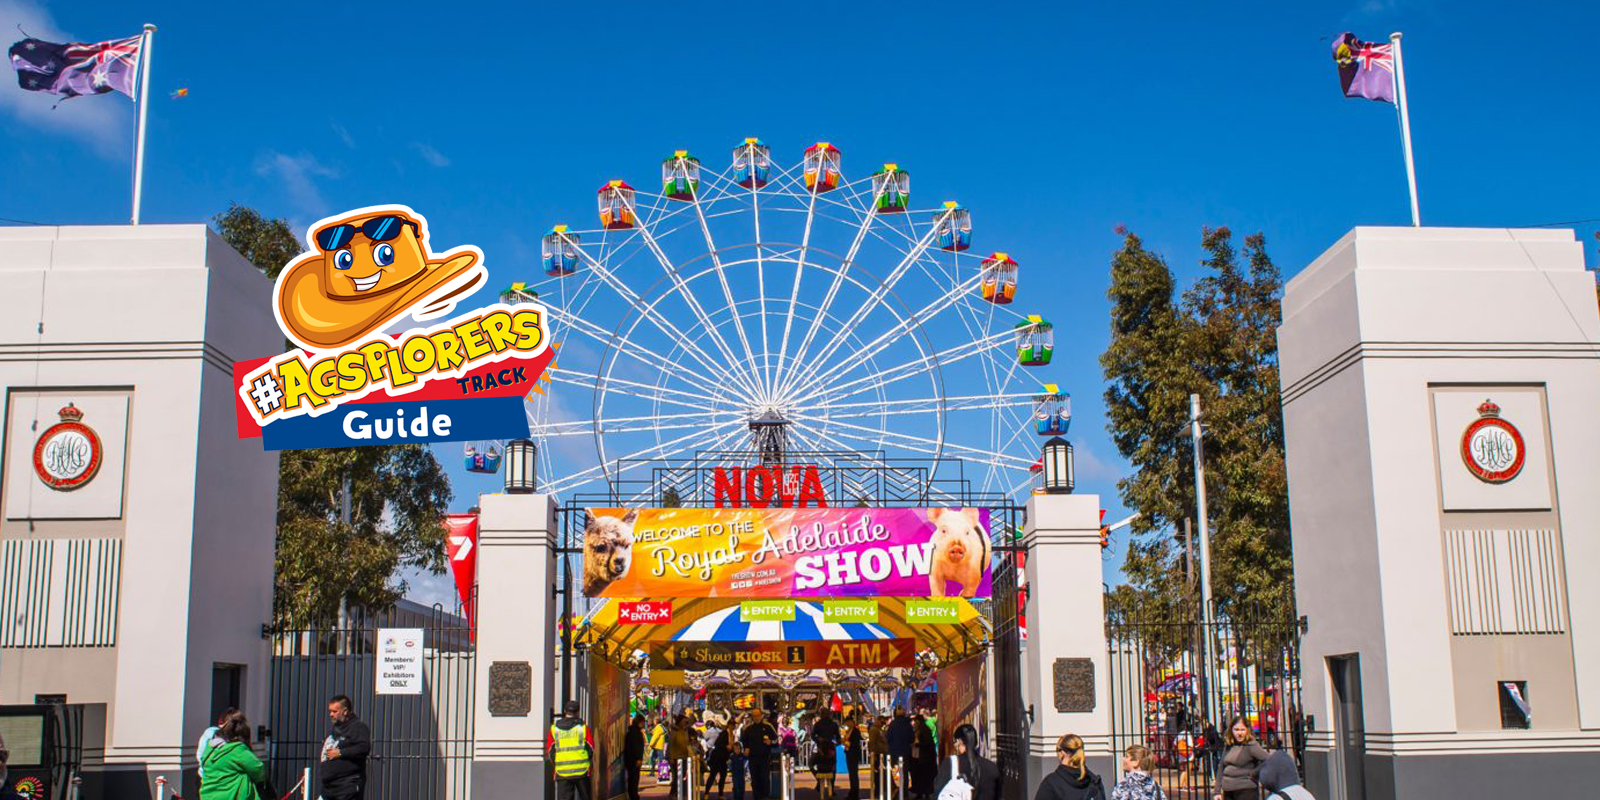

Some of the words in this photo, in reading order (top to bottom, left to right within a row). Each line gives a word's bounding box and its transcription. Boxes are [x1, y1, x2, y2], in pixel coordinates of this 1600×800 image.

[714, 465, 828, 508] NOVA
[633, 525, 701, 543] WELCOME
[704, 523, 724, 536] TO
[728, 520, 754, 535] THE
[652, 534, 745, 580] Royal
[752, 515, 890, 564] Adelaide
[794, 542, 936, 590] SHOW
[636, 604, 651, 613] NO
[752, 606, 785, 615] ENTRY
[835, 607, 867, 616] ENTRY
[916, 607, 950, 616] ENTRY
[631, 612, 659, 621] ENTRY
[695, 648, 731, 662] Show
[735, 651, 783, 662] KIOSK
[826, 644, 881, 665] ATM
